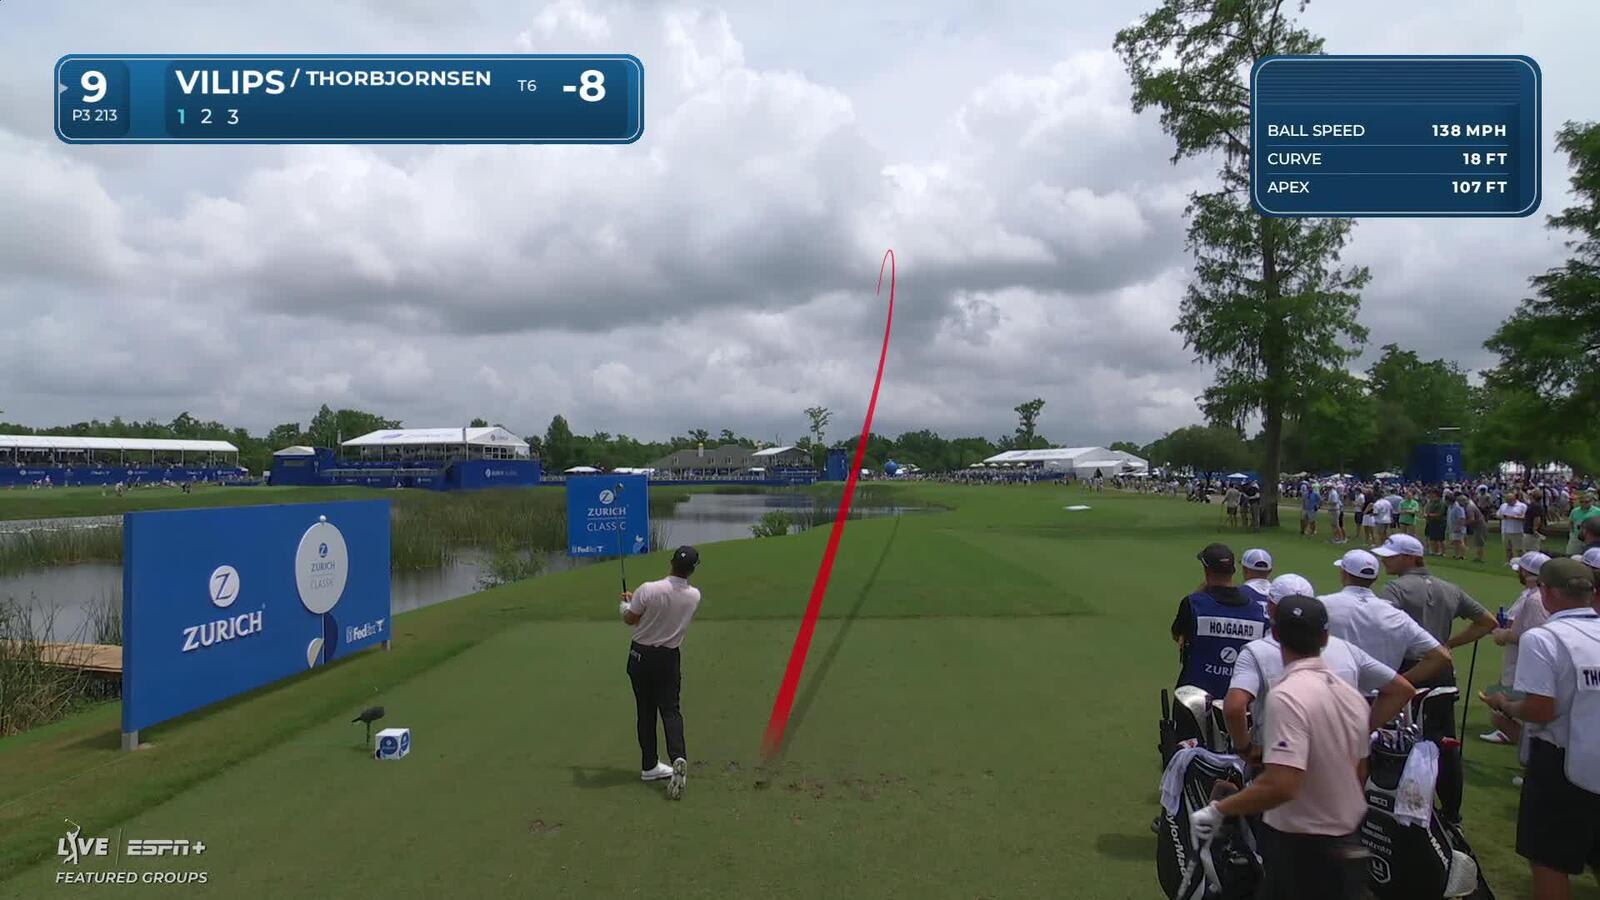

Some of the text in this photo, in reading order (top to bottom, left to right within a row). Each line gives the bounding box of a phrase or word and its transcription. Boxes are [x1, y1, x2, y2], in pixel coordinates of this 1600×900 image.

[1446, 454, 1453, 463] 8
[587, 507, 626, 517] ZURICH
[587, 521, 626, 532] CLASSC
[311, 560, 335, 572] ZURICH
[181, 610, 263, 653] ZURICH
[1209, 621, 1254, 637] HOJGAARD
[1204, 663, 1233, 677] ZURI
